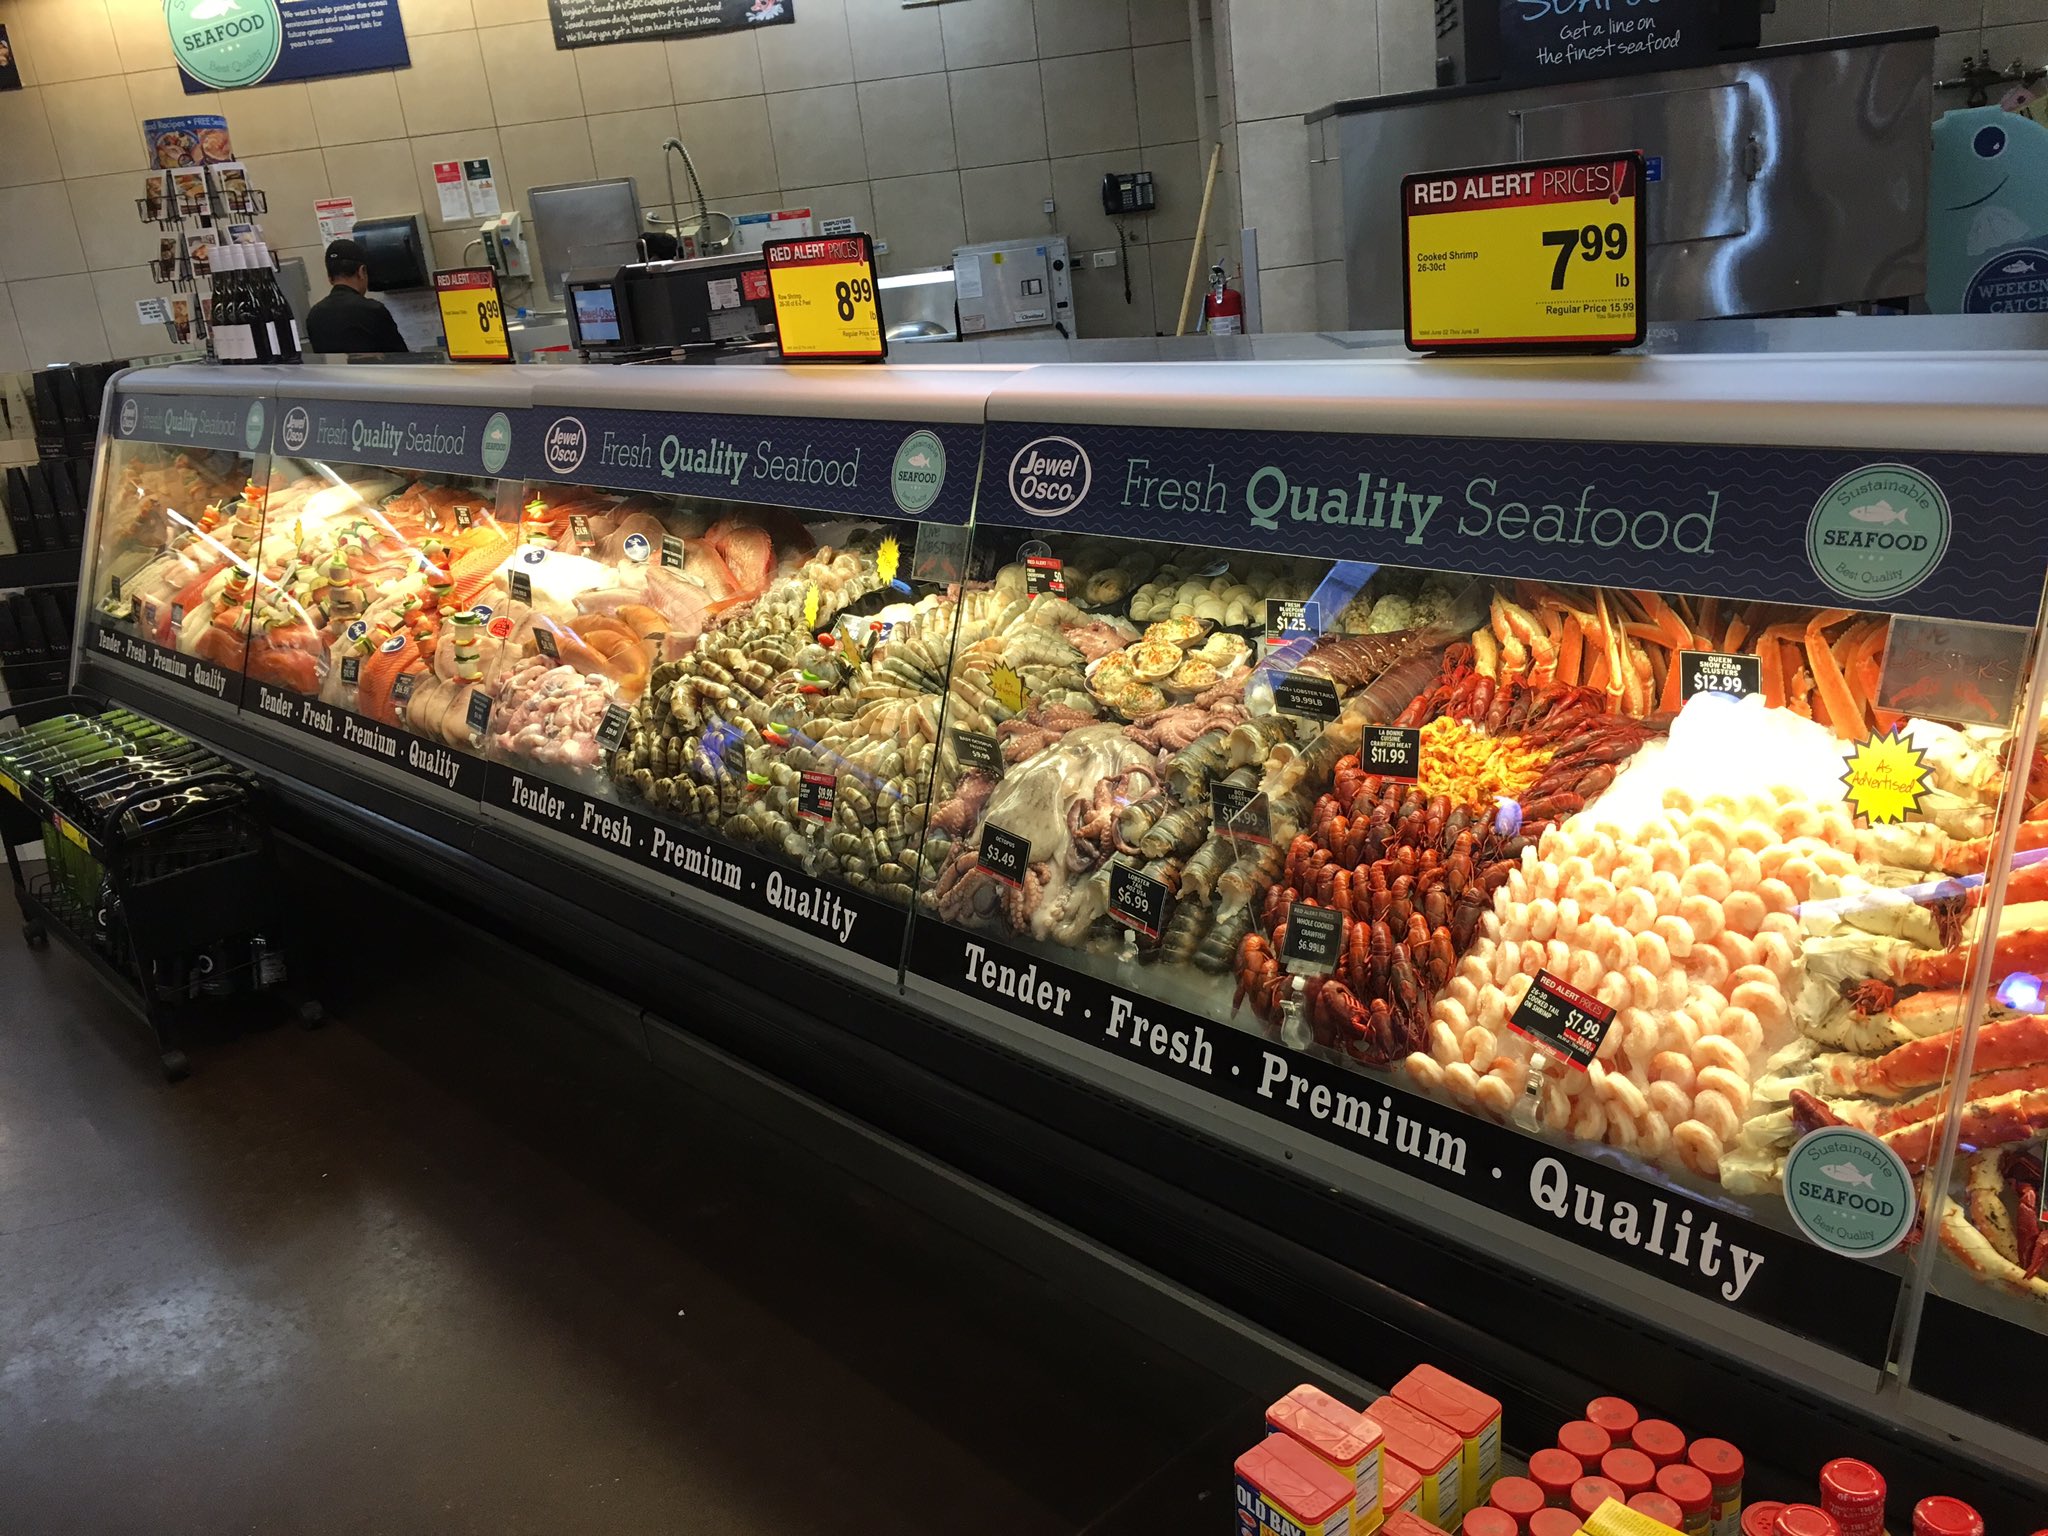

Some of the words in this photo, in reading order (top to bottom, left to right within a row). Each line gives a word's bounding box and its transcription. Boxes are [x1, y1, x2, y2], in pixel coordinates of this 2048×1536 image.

[285, 18, 324, 28] environment
[325, 15, 337, 23] and
[339, 13, 356, 22] make
[371, 9, 384, 17] that
[294, 9, 310, 17] want
[318, 6, 332, 14] help
[333, 4, 356, 13] protect
[356, 1, 367, 9] the
[564, 19, 584, 30] Jewel
[585, 18, 611, 27] receives
[611, 14, 630, 25] daily
[630, 9, 666, 23] shipments
[667, 6, 675, 17] of
[676, 5, 695, 16] fresh
[182, 14, 265, 52] SEAFOOD
[307, 26, 344, 37] generations
[344, 23, 360, 31] have
[361, 21, 372, 29] fish
[581, 31, 597, 41] help
[597, 30, 611, 41] you
[612, 27, 625, 39] get
[632, 25, 644, 34] line
[1560, 20, 1591, 40] Get
[1593, 24, 1605, 35] a
[1609, 18, 1634, 35] line
[1637, 15, 1656, 30] on
[290, 40, 307, 49] years
[1536, 47, 1563, 65] the
[1565, 39, 1615, 65] finest
[1617, 29, 1682, 55] seafood
[1414, 181, 1458, 205] RED
[1463, 171, 1535, 201] ALERT
[769, 246, 792, 262] RED
[793, 243, 825, 260] ALERT
[1417, 251, 1448, 262] Cooked
[1449, 250, 1479, 262] Shrimp
[1417, 262, 1447, 273] 26-30ct
[437, 275, 451, 286] RED
[451, 273, 470, 285] ALERT
[1615, 273, 1630, 288] lb
[1546, 305, 1581, 316] Regular
[1583, 303, 1607, 313] Price
[1610, 302, 1634, 312] 15.99
[164, 408, 198, 438] Quality
[199, 409, 238, 436] Seafood
[287, 414, 307, 429] Jewel
[286, 428, 304, 442] Osco
[316, 417, 349, 446] Fresh
[351, 419, 404, 456] Quality
[405, 422, 467, 456] Seafood
[550, 426, 582, 447] Jewel
[549, 445, 575, 463] Osco
[600, 431, 653, 470] Fresh
[659, 434, 749, 487] Quality
[753, 440, 861, 488] Seafood
[1020, 449, 1081, 478] Jewel
[897, 470, 937, 484] SEAFOOD
[1020, 474, 1072, 502] Osco
[1837, 479, 1930, 511] Sustainable
[1120, 458, 1229, 515] Fresh
[1245, 465, 1443, 546] Quality
[1457, 477, 1721, 556] Seafood
[1823, 529, 1929, 552] SEAFOOD
[1835, 561, 1858, 581] Best
[1861, 569, 1903, 584] Quality
[1277, 616, 1307, 631] $1.25
[98, 629, 121, 653] Tender
[125, 638, 147, 664] Fresh
[152, 648, 187, 679] Premium
[193, 662, 226, 697] Quality
[1699, 661, 1721, 669] SNOW
[1721, 663, 1742, 671] CRAB
[1708, 656, 1733, 664] QUEEN
[1693, 672, 1742, 693] $12.99
[1702, 667, 1739, 677] CLUSTERS
[1293, 687, 1319, 696] LOBSTER
[1319, 691, 1335, 699] TAILS
[259, 686, 293, 719] Tender
[301, 701, 333, 734] Fresh
[343, 715, 396, 758] Premium
[408, 739, 461, 788] Quality
[1371, 746, 1406, 764] $11.99
[1875, 759, 1893, 774] As
[1222, 803, 1258, 826] $14.99
[995, 835, 1016, 849] OCTOPUS
[511, 775, 566, 821] Tender
[580, 800, 633, 848] Fresh
[650, 826, 743, 891] Premium
[766, 869, 858, 943] Quality
[986, 843, 1015, 867] $3.49
[1127, 873, 1150, 888] LOBSTER
[1131, 880, 1143, 891] TAIL
[1117, 886, 1149, 912] $6.99
[1136, 889, 1147, 898] USA
[1296, 917, 1314, 927] WHOLE
[1313, 920, 1335, 931] COOKED
[1300, 928, 1327, 940] CRAWFISH
[1530, 986, 1548, 1000] 26-30
[1539, 975, 1557, 989] RED
[1555, 984, 1580, 1002] ALERT
[1523, 999, 1532, 1009] ON
[1531, 1004, 1553, 1020] SHRIMP
[1527, 993, 1549, 1010] COOKED
[1547, 1005, 1560, 1017] TAIL
[1564, 1009, 1600, 1040] $7.99
[965, 942, 1071, 1019] Tender
[1104, 994, 1214, 1075] Fresh
[1255, 1051, 1468, 1177] Premium
[1528, 1156, 1765, 1302] Quality
[1807, 1141, 1893, 1179] Sustainable
[1799, 1181, 1895, 1217] SEAFOOD
[1812, 1213, 1835, 1235] Best
[1836, 1227, 1875, 1241] Quality
[1236, 1484, 1266, 1521] OLD
[1269, 1509, 1301, 1536] BAY
